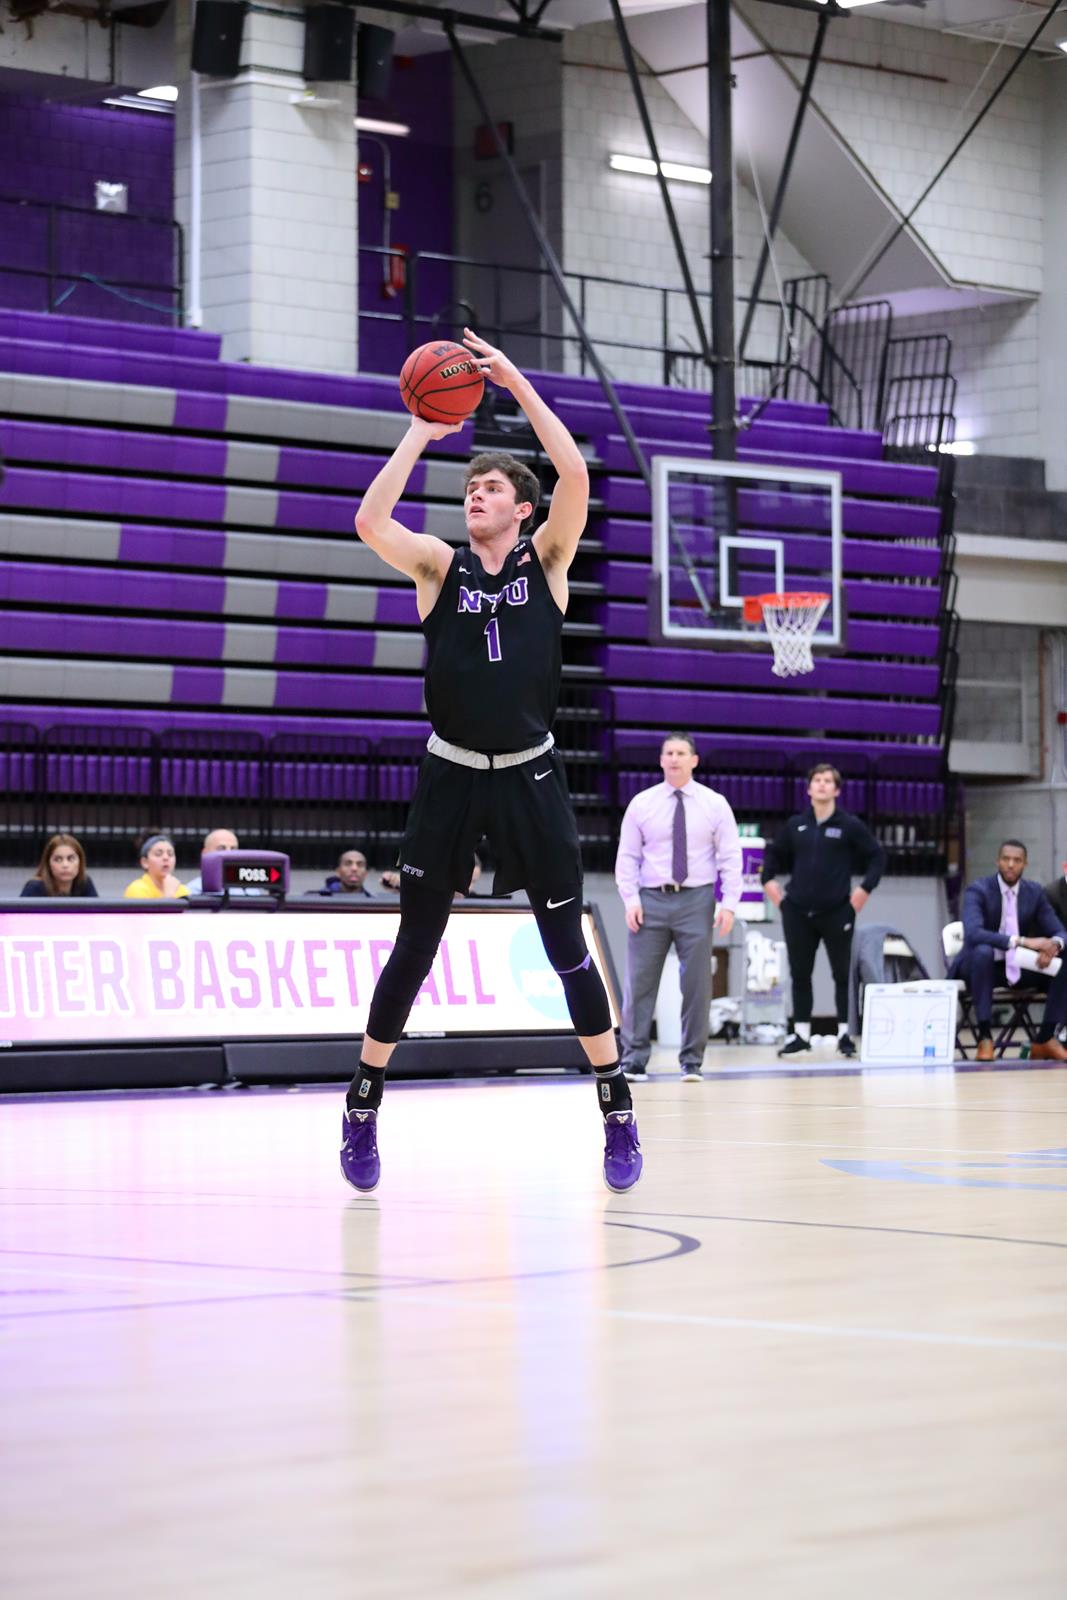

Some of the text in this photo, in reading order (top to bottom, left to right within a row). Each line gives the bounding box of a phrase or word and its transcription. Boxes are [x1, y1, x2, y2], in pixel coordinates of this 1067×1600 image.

[440, 360, 480, 379] ilson
[457, 577, 529, 613] NYU
[484, 617, 502, 662] 1
[238, 867, 269, 882] POSS.
